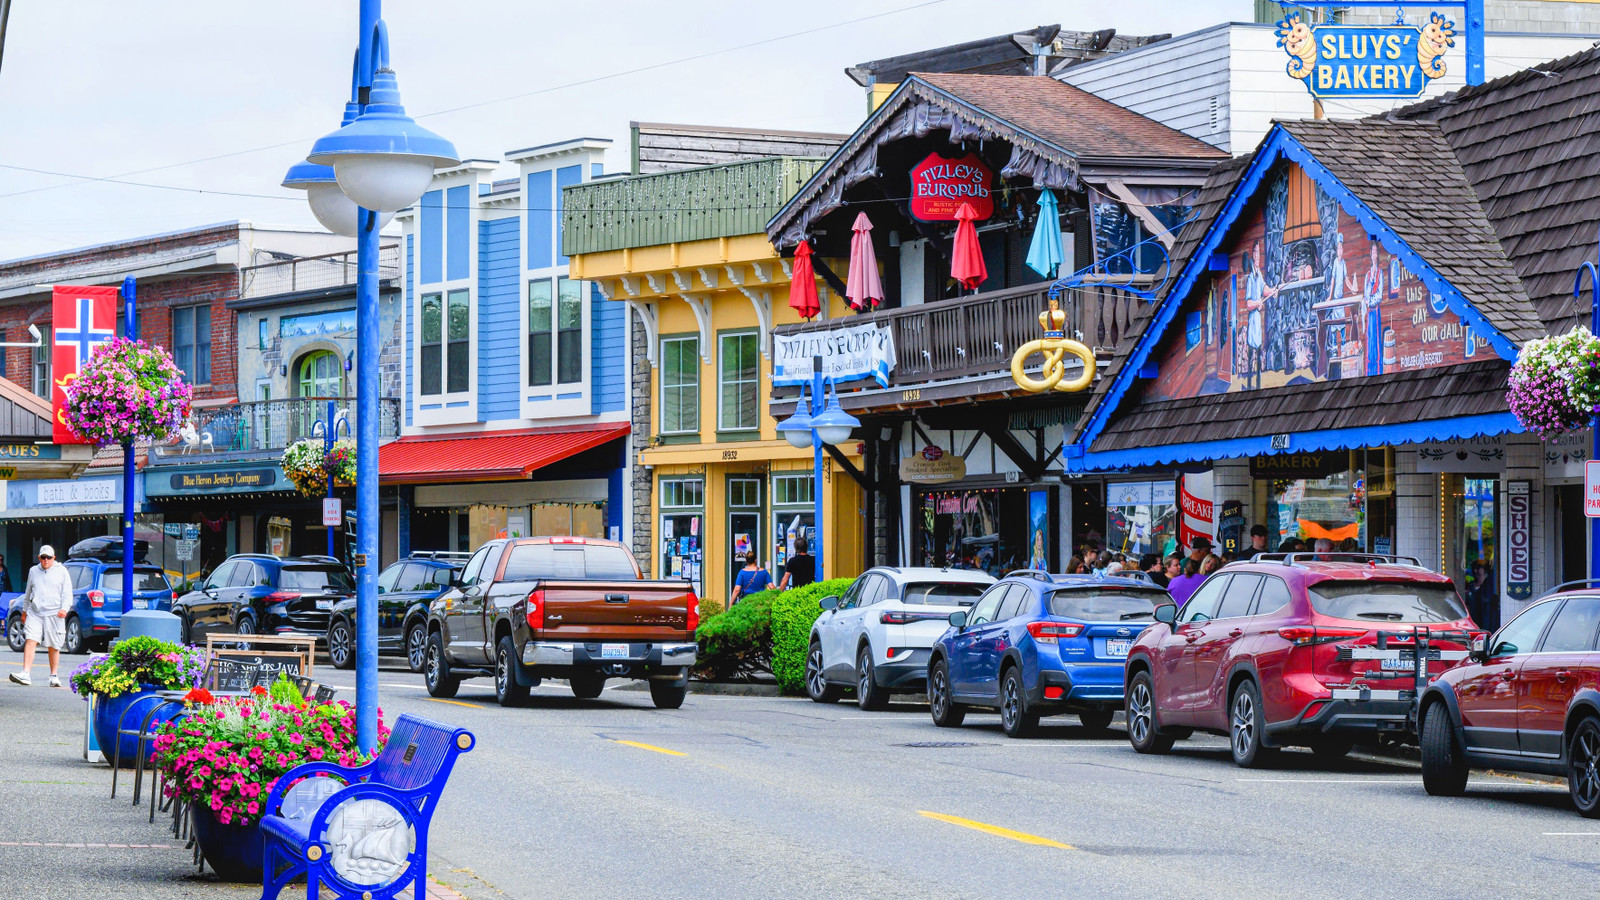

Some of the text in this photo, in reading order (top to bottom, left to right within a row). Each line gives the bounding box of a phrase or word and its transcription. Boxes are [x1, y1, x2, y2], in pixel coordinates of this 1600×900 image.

[1321, 34, 1412, 59] SLUYS'
[1318, 64, 1416, 89] BAKERY
[920, 163, 984, 183] TIZLEY'S
[1421, 325, 1439, 343] OUR
[1470, 435, 1501, 446] PLUM
[1568, 434, 1585, 446] PLUM
[722, 450, 738, 460] 18932
[1256, 455, 1323, 469] BAKERY
[183, 472, 261, 486] Blue Heron Jewelry Company
[43, 482, 111, 502] bath & books
[936, 492, 979, 515] Crimson Cove
[1510, 496, 1528, 581] SHOES
[634, 615, 684, 623] TUNDRA
[278, 662, 300, 676] JAVA
